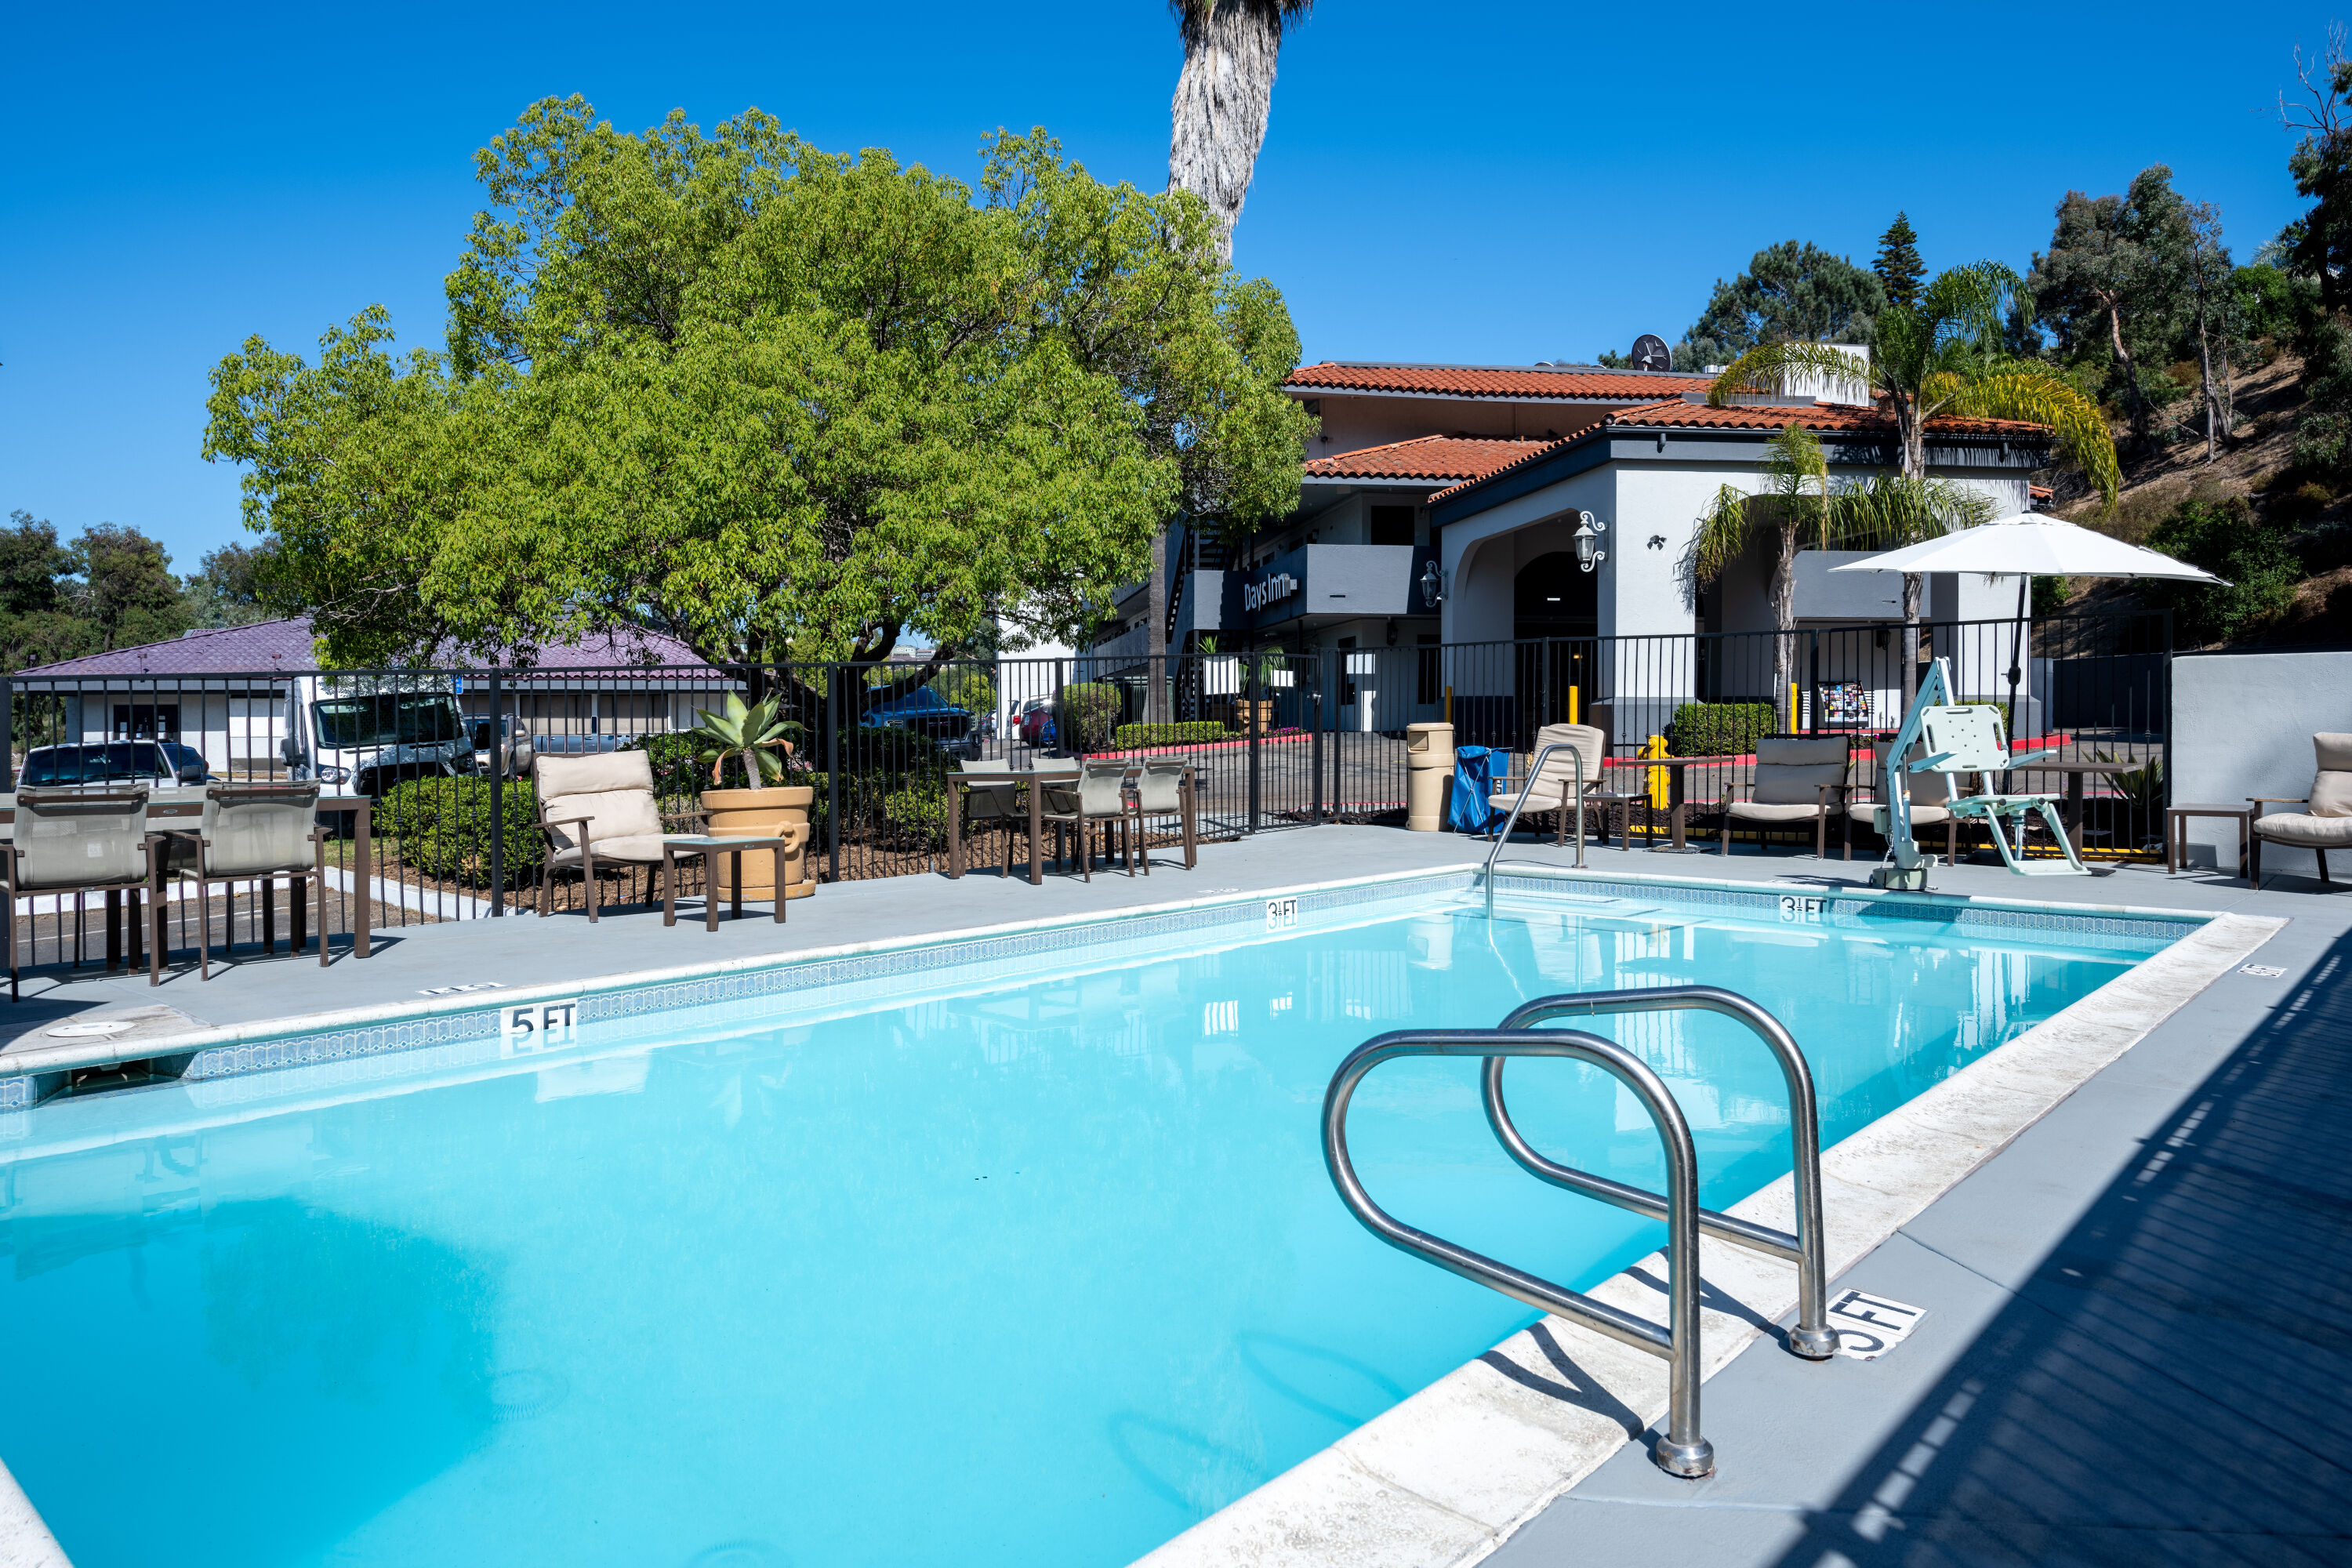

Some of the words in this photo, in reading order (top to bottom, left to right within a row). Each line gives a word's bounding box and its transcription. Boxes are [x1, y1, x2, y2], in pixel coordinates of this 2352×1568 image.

[1244, 583, 1267, 612] Days
[1268, 572, 1285, 602] Inn
[510, 1007, 534, 1034] 5
[543, 1003, 576, 1030] FT
[1828, 1290, 1918, 1331] FT
